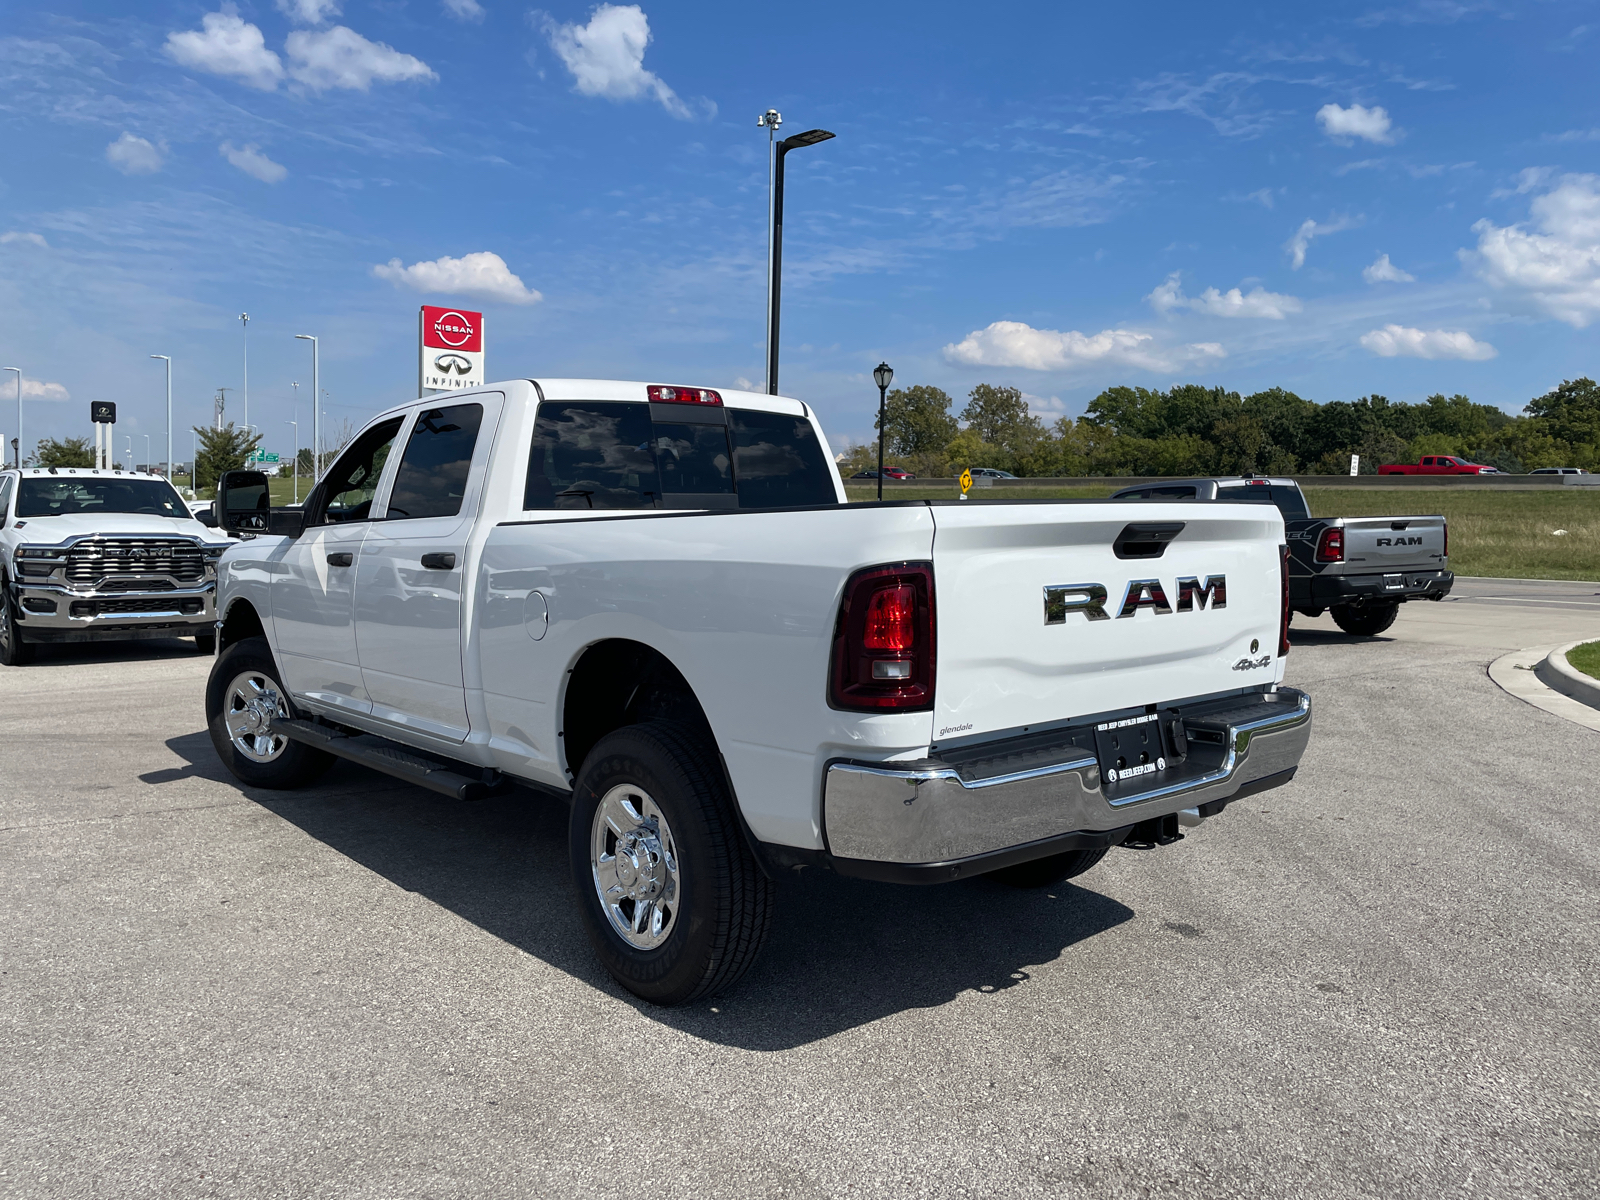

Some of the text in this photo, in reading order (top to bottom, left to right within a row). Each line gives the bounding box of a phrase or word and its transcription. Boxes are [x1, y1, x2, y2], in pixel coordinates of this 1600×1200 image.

[434, 323, 473, 334] NISSAN
[1377, 537, 1422, 546] RAM
[104, 547, 171, 557] RAM
[1043, 574, 1227, 626] RAM
[939, 722, 973, 737] glendale
[1098, 723, 1107, 731] REED
[1108, 721, 1117, 729] JEEP
[1118, 718, 1136, 727] CHRYSLER
[1137, 715, 1148, 723] DODGE
